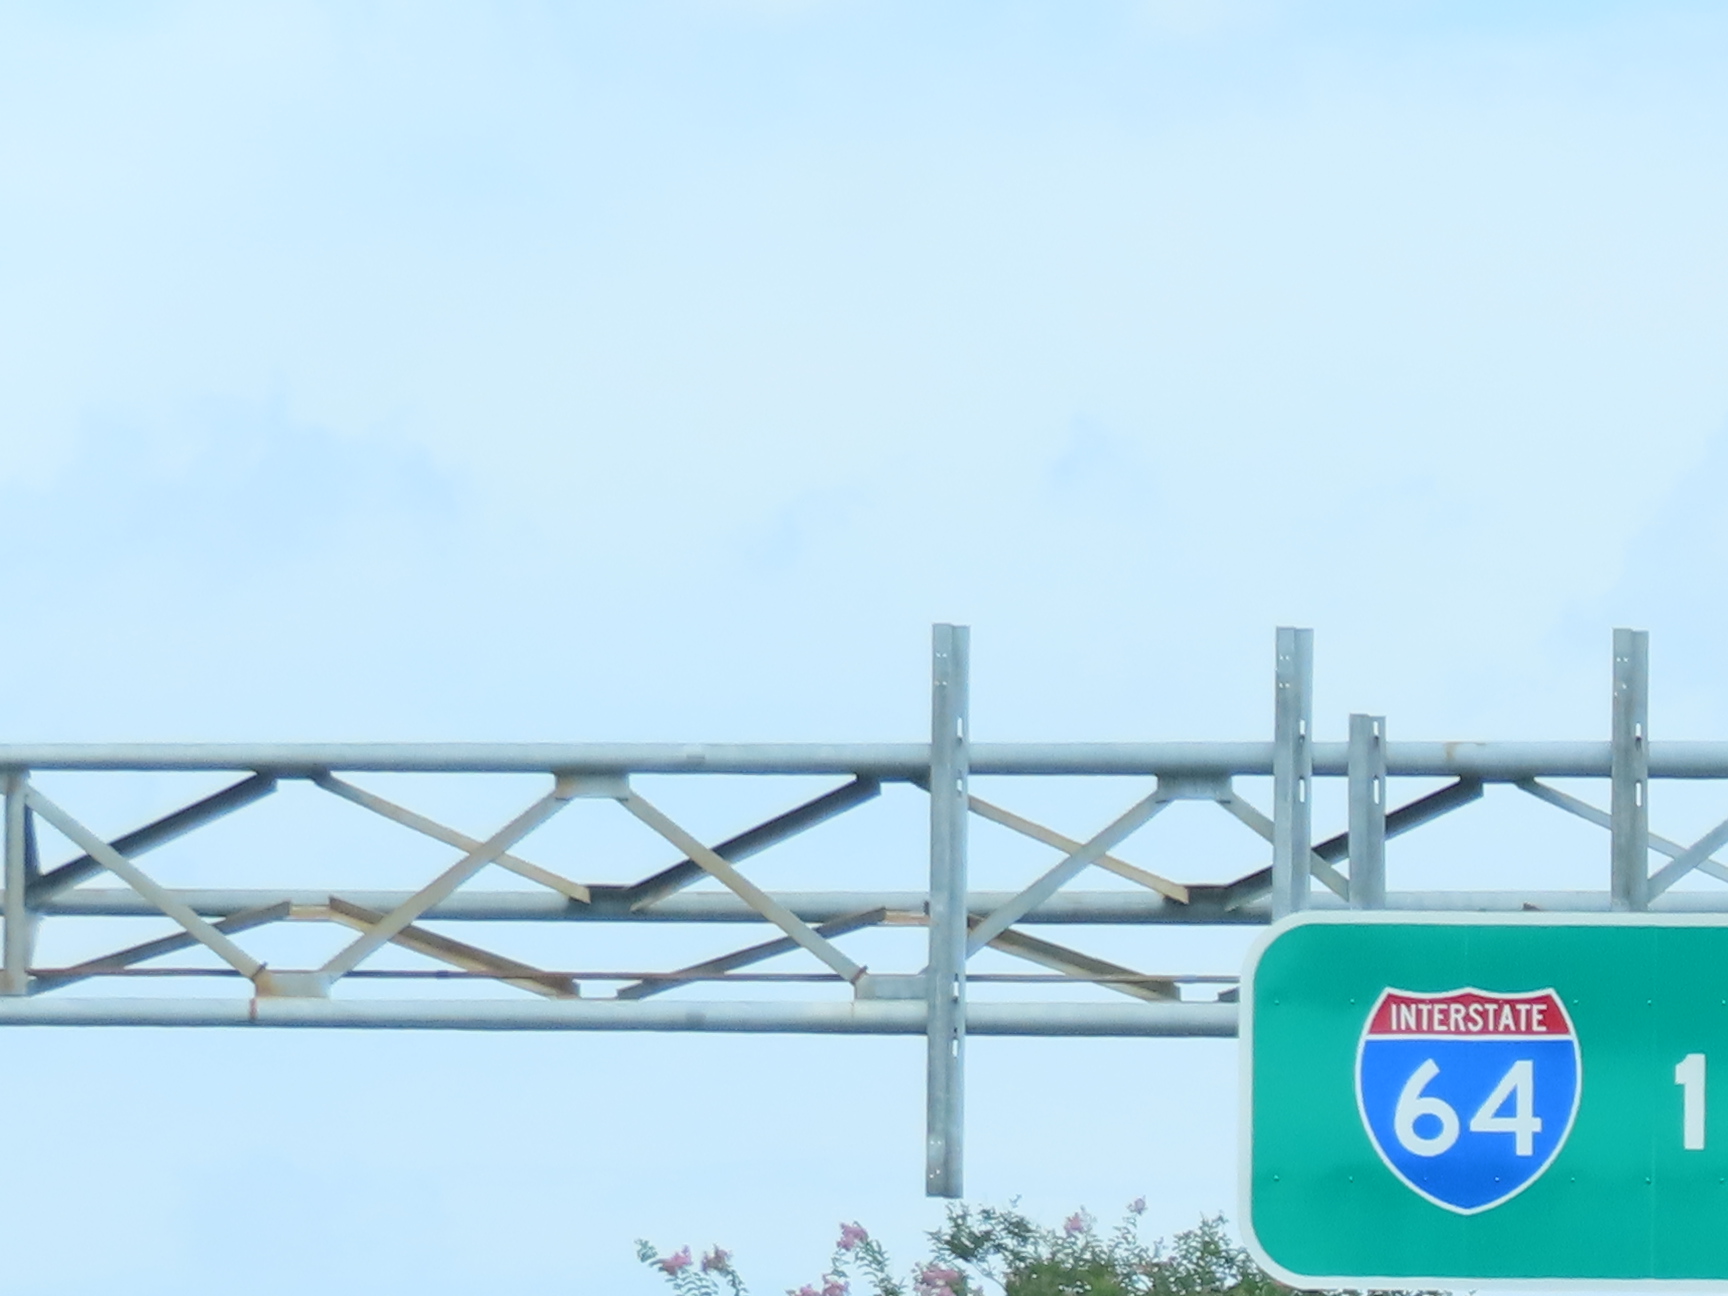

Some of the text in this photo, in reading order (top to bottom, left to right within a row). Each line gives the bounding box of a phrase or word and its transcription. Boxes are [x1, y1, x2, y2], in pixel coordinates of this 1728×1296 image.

[1390, 1001, 1548, 1033] INTERSTATE
[1394, 1058, 1542, 1157] 64
[1675, 1053, 1706, 1150] 1
